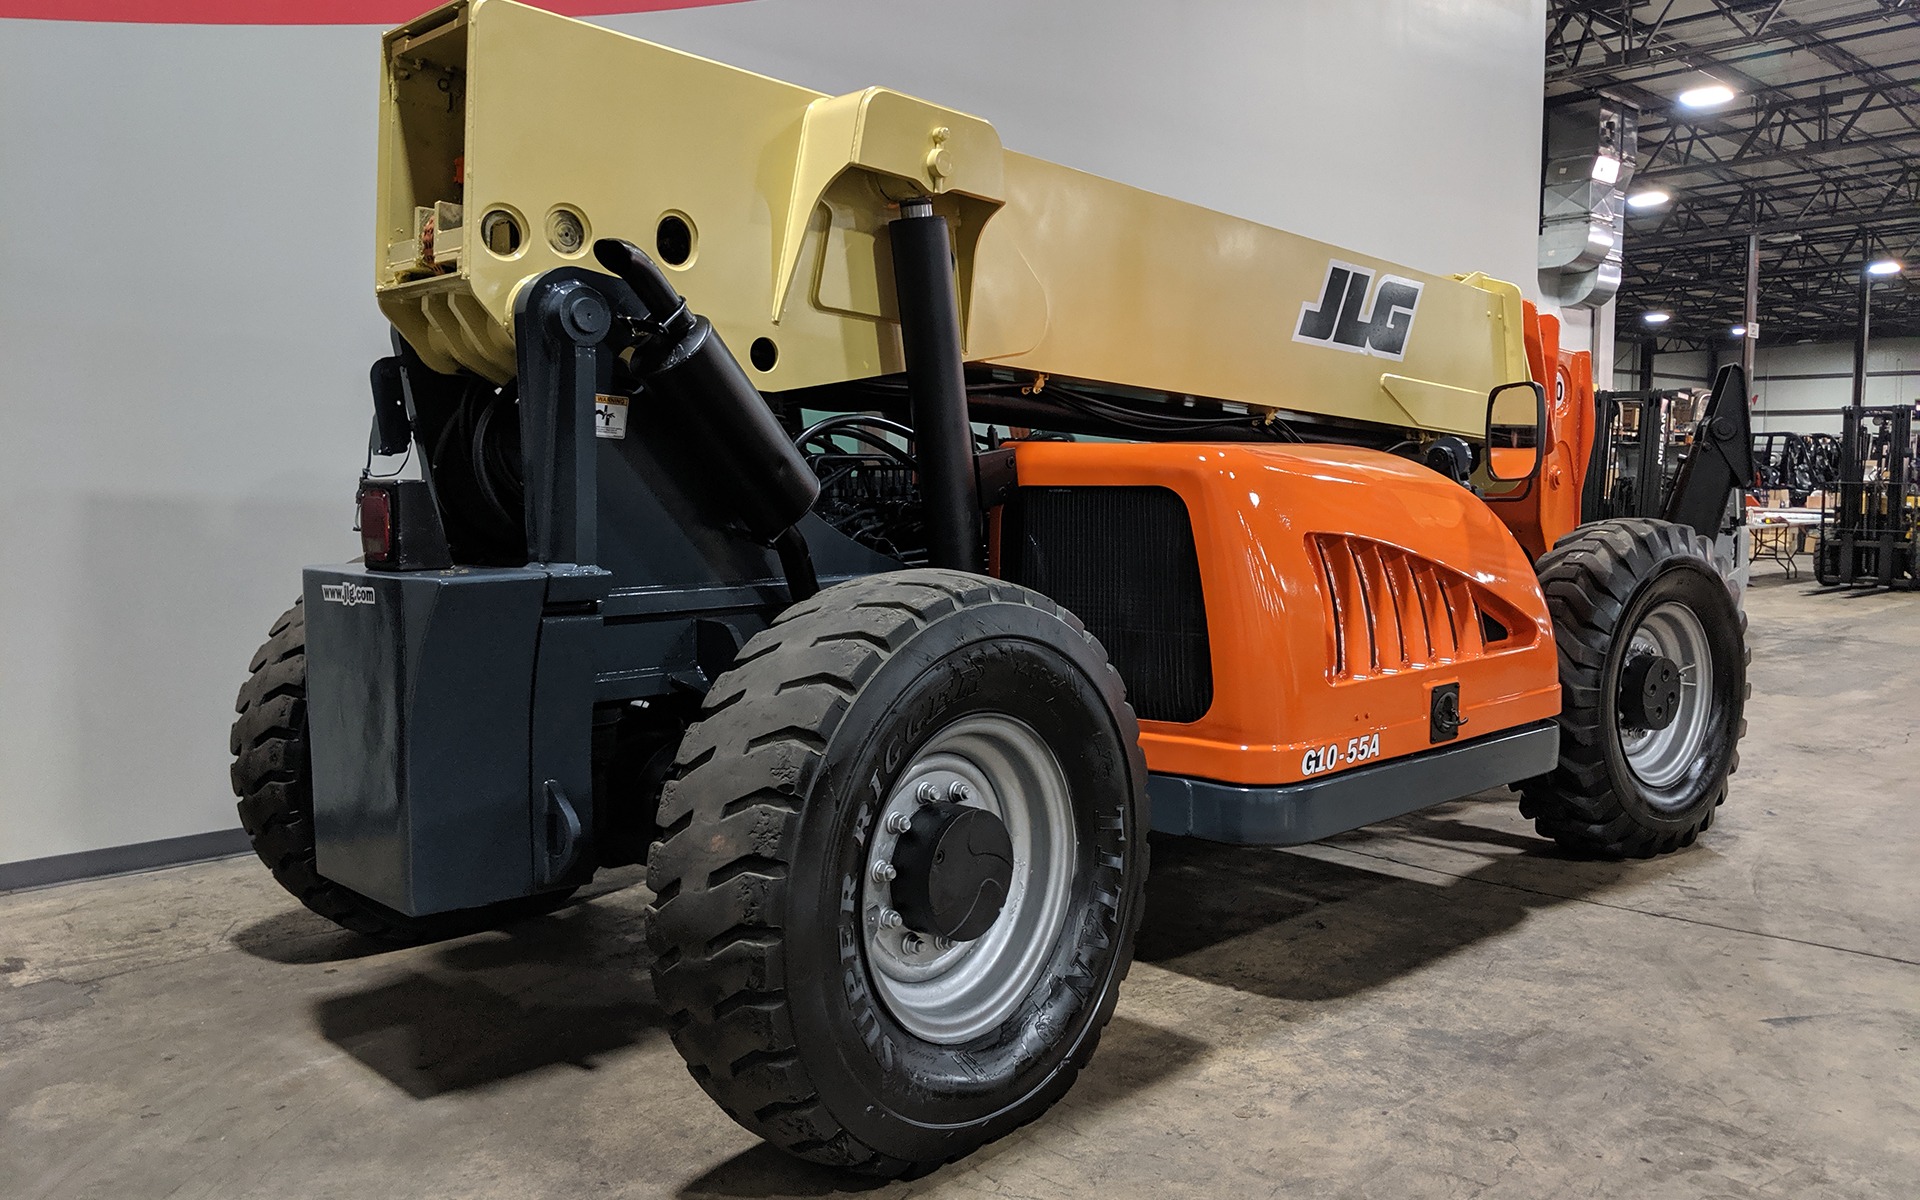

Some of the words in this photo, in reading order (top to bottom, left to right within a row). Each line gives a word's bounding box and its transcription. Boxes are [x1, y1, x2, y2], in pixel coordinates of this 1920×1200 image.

[1297, 266, 1420, 356] JLG
[1657, 413, 1667, 465] NISSAN
[323, 584, 375, 604] www.jlg.com
[1060, 804, 1127, 1009] TITAN
[837, 872, 897, 1073] SUPER
